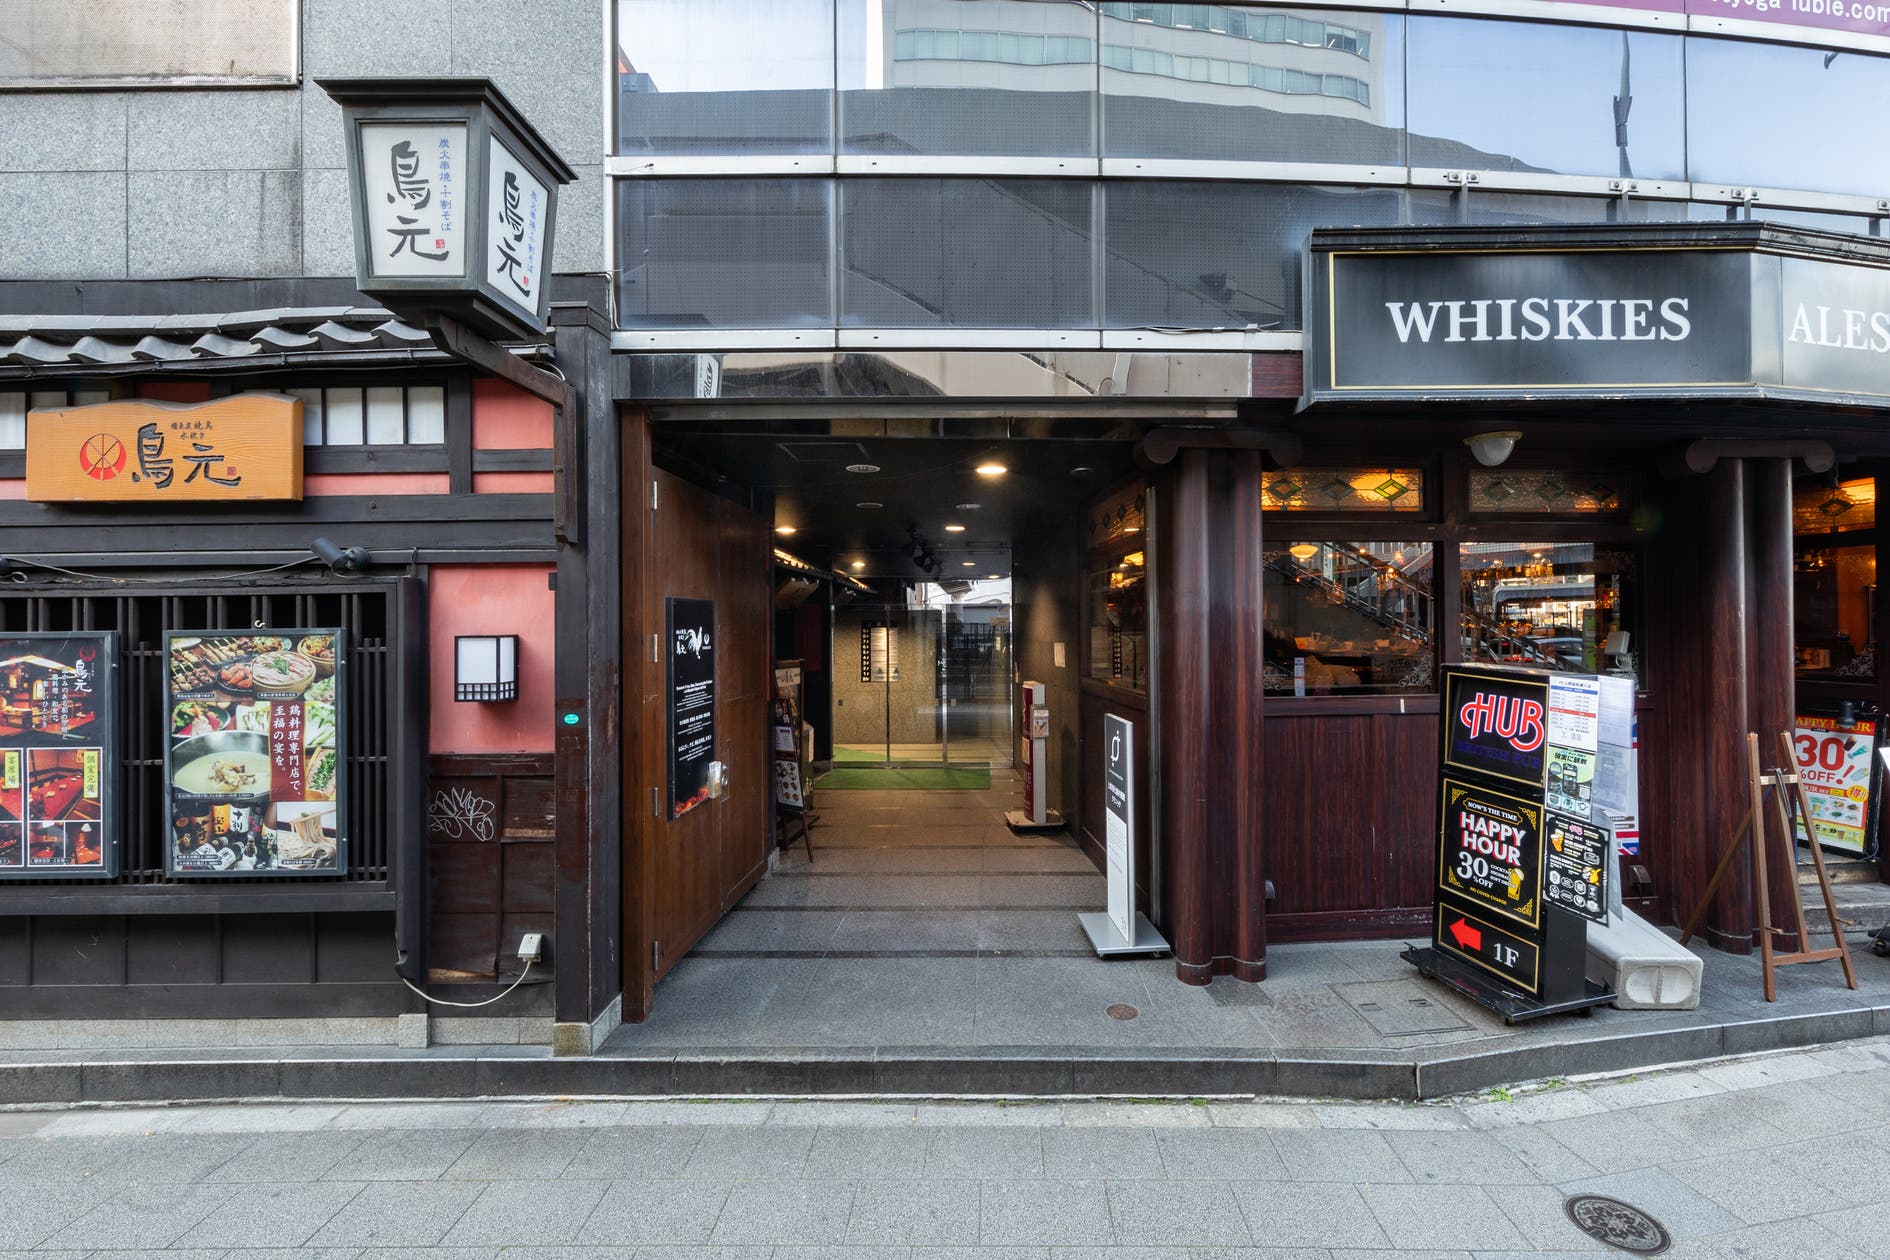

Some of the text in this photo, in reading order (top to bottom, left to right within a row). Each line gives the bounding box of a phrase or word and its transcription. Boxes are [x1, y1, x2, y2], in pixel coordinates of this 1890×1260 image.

[386, 140, 449, 261] 鳥元
[438, 138, 452, 232] 炭火串焼・十割そば
[496, 171, 530, 298] 鳥元
[1385, 297, 1691, 344] WHISKIES
[1788, 303, 1890, 353] ALES
[132, 423, 241, 489] 鳥元
[273, 705, 287, 772] 至福の宴を。
[1460, 692, 1545, 752] HUB
[288, 704, 301, 796] 鶏料理専門店で、
[1796, 734, 1845, 771] 30
[1459, 811, 1526, 847] HAPPY
[1467, 801, 1518, 822] NOW'S THE TIME
[1456, 851, 1489, 879] 30
[1461, 833, 1521, 867] HOUR
[1473, 875, 1494, 889] %OFF
[1493, 942, 1520, 968] 1F
